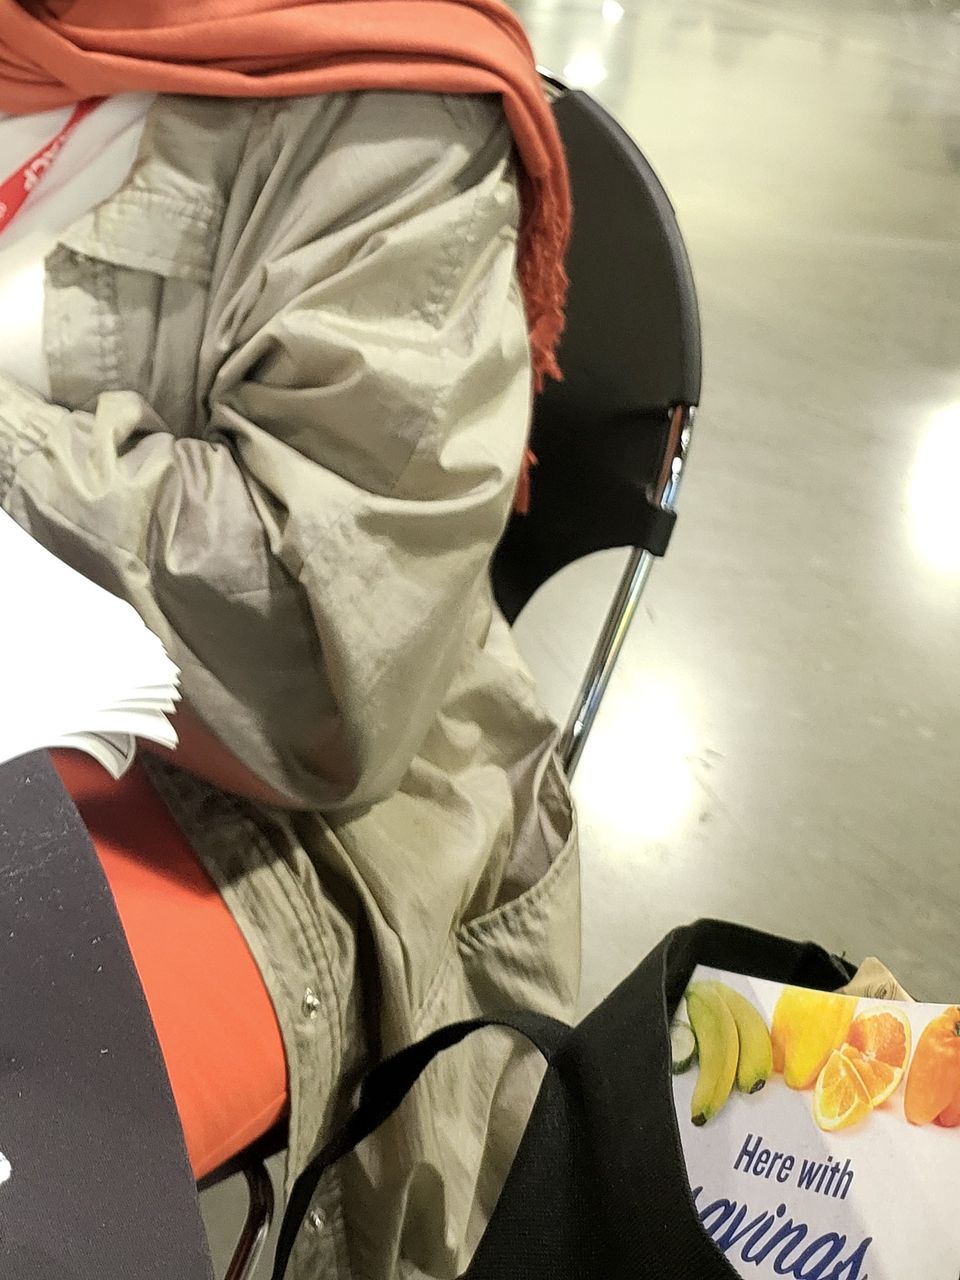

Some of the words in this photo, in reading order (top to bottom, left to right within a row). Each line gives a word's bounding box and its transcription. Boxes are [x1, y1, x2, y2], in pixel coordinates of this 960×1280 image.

[733, 1133, 795, 1183] Here
[797, 1155, 854, 1200] with
[690, 1186, 873, 1280] avings
